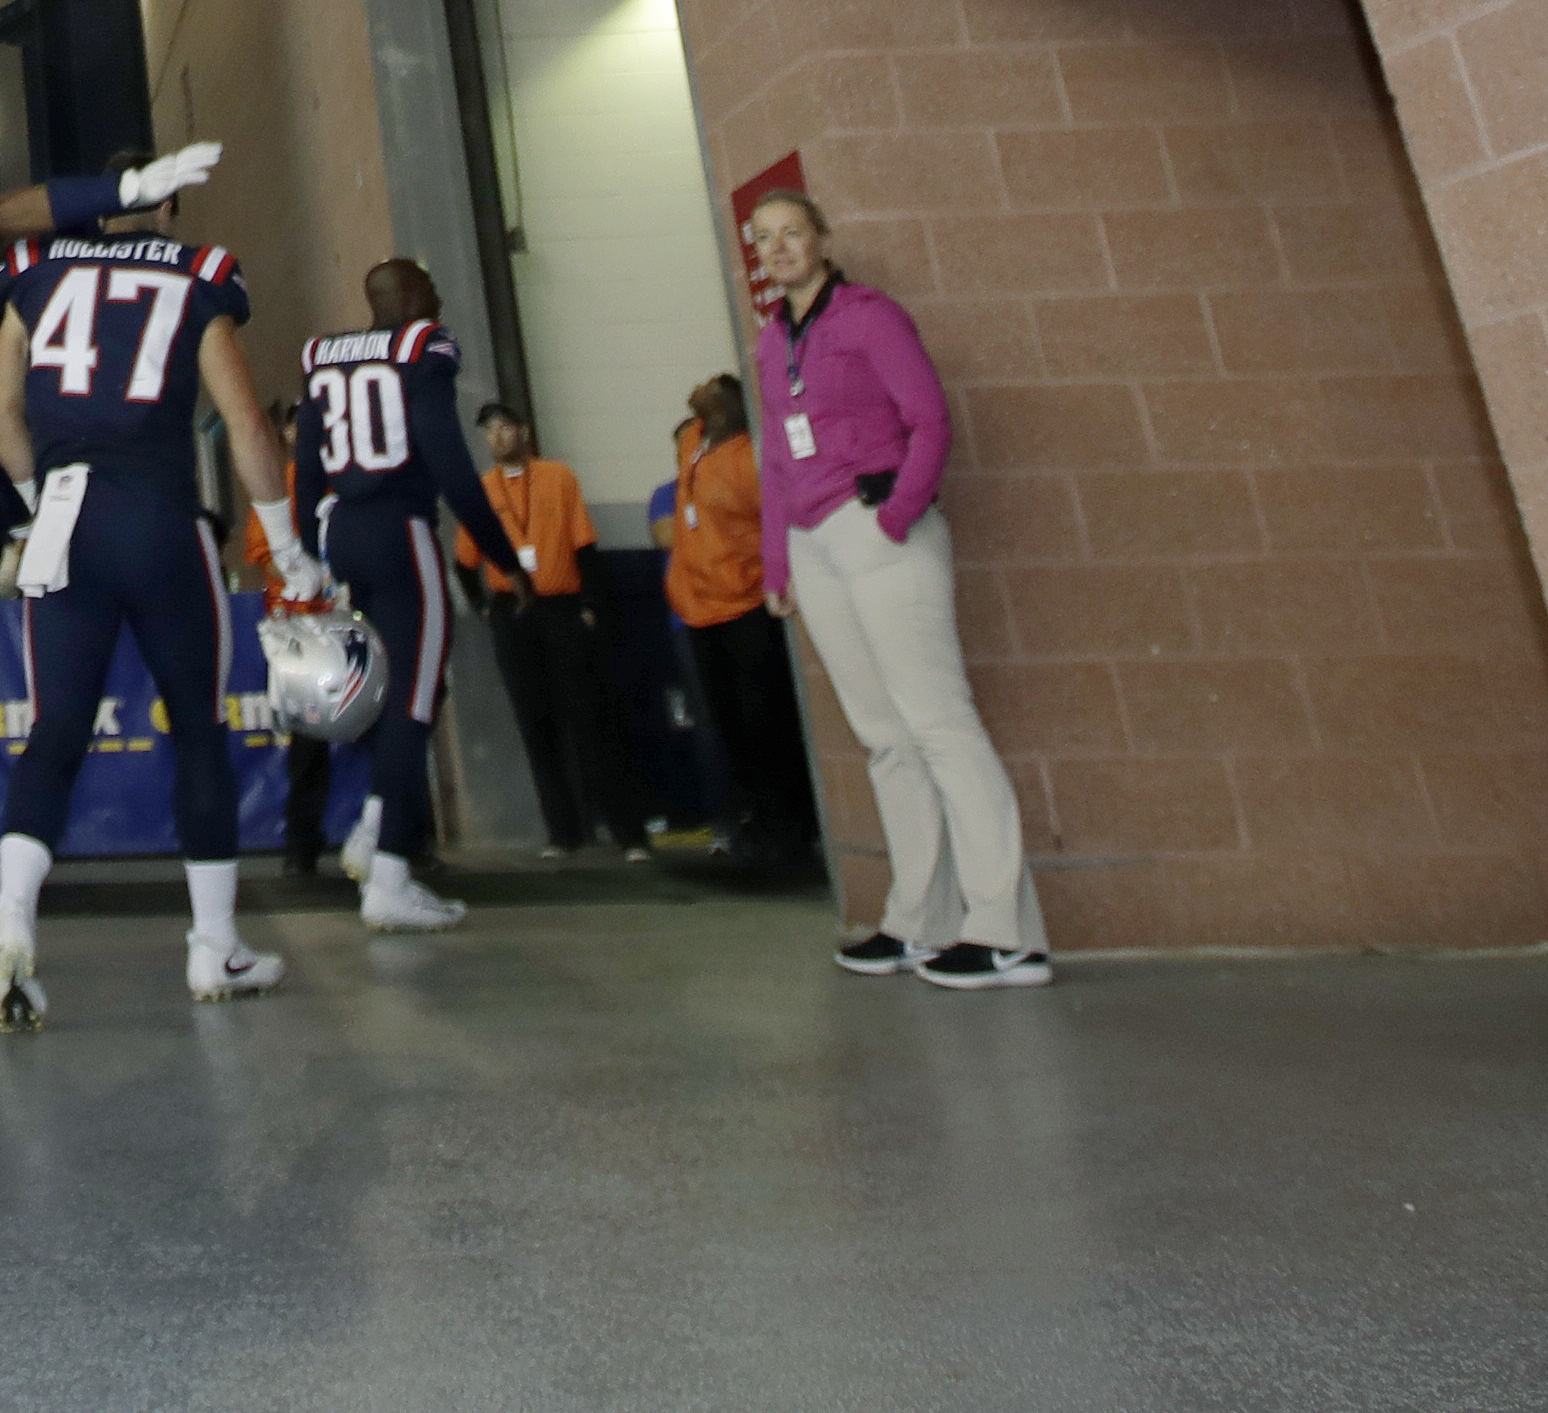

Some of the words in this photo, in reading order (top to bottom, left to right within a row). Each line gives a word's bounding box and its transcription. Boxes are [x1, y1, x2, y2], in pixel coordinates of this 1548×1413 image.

[48, 238, 183, 265] HOLLISTER
[29, 265, 197, 403] 47
[309, 364, 411, 475] 30
